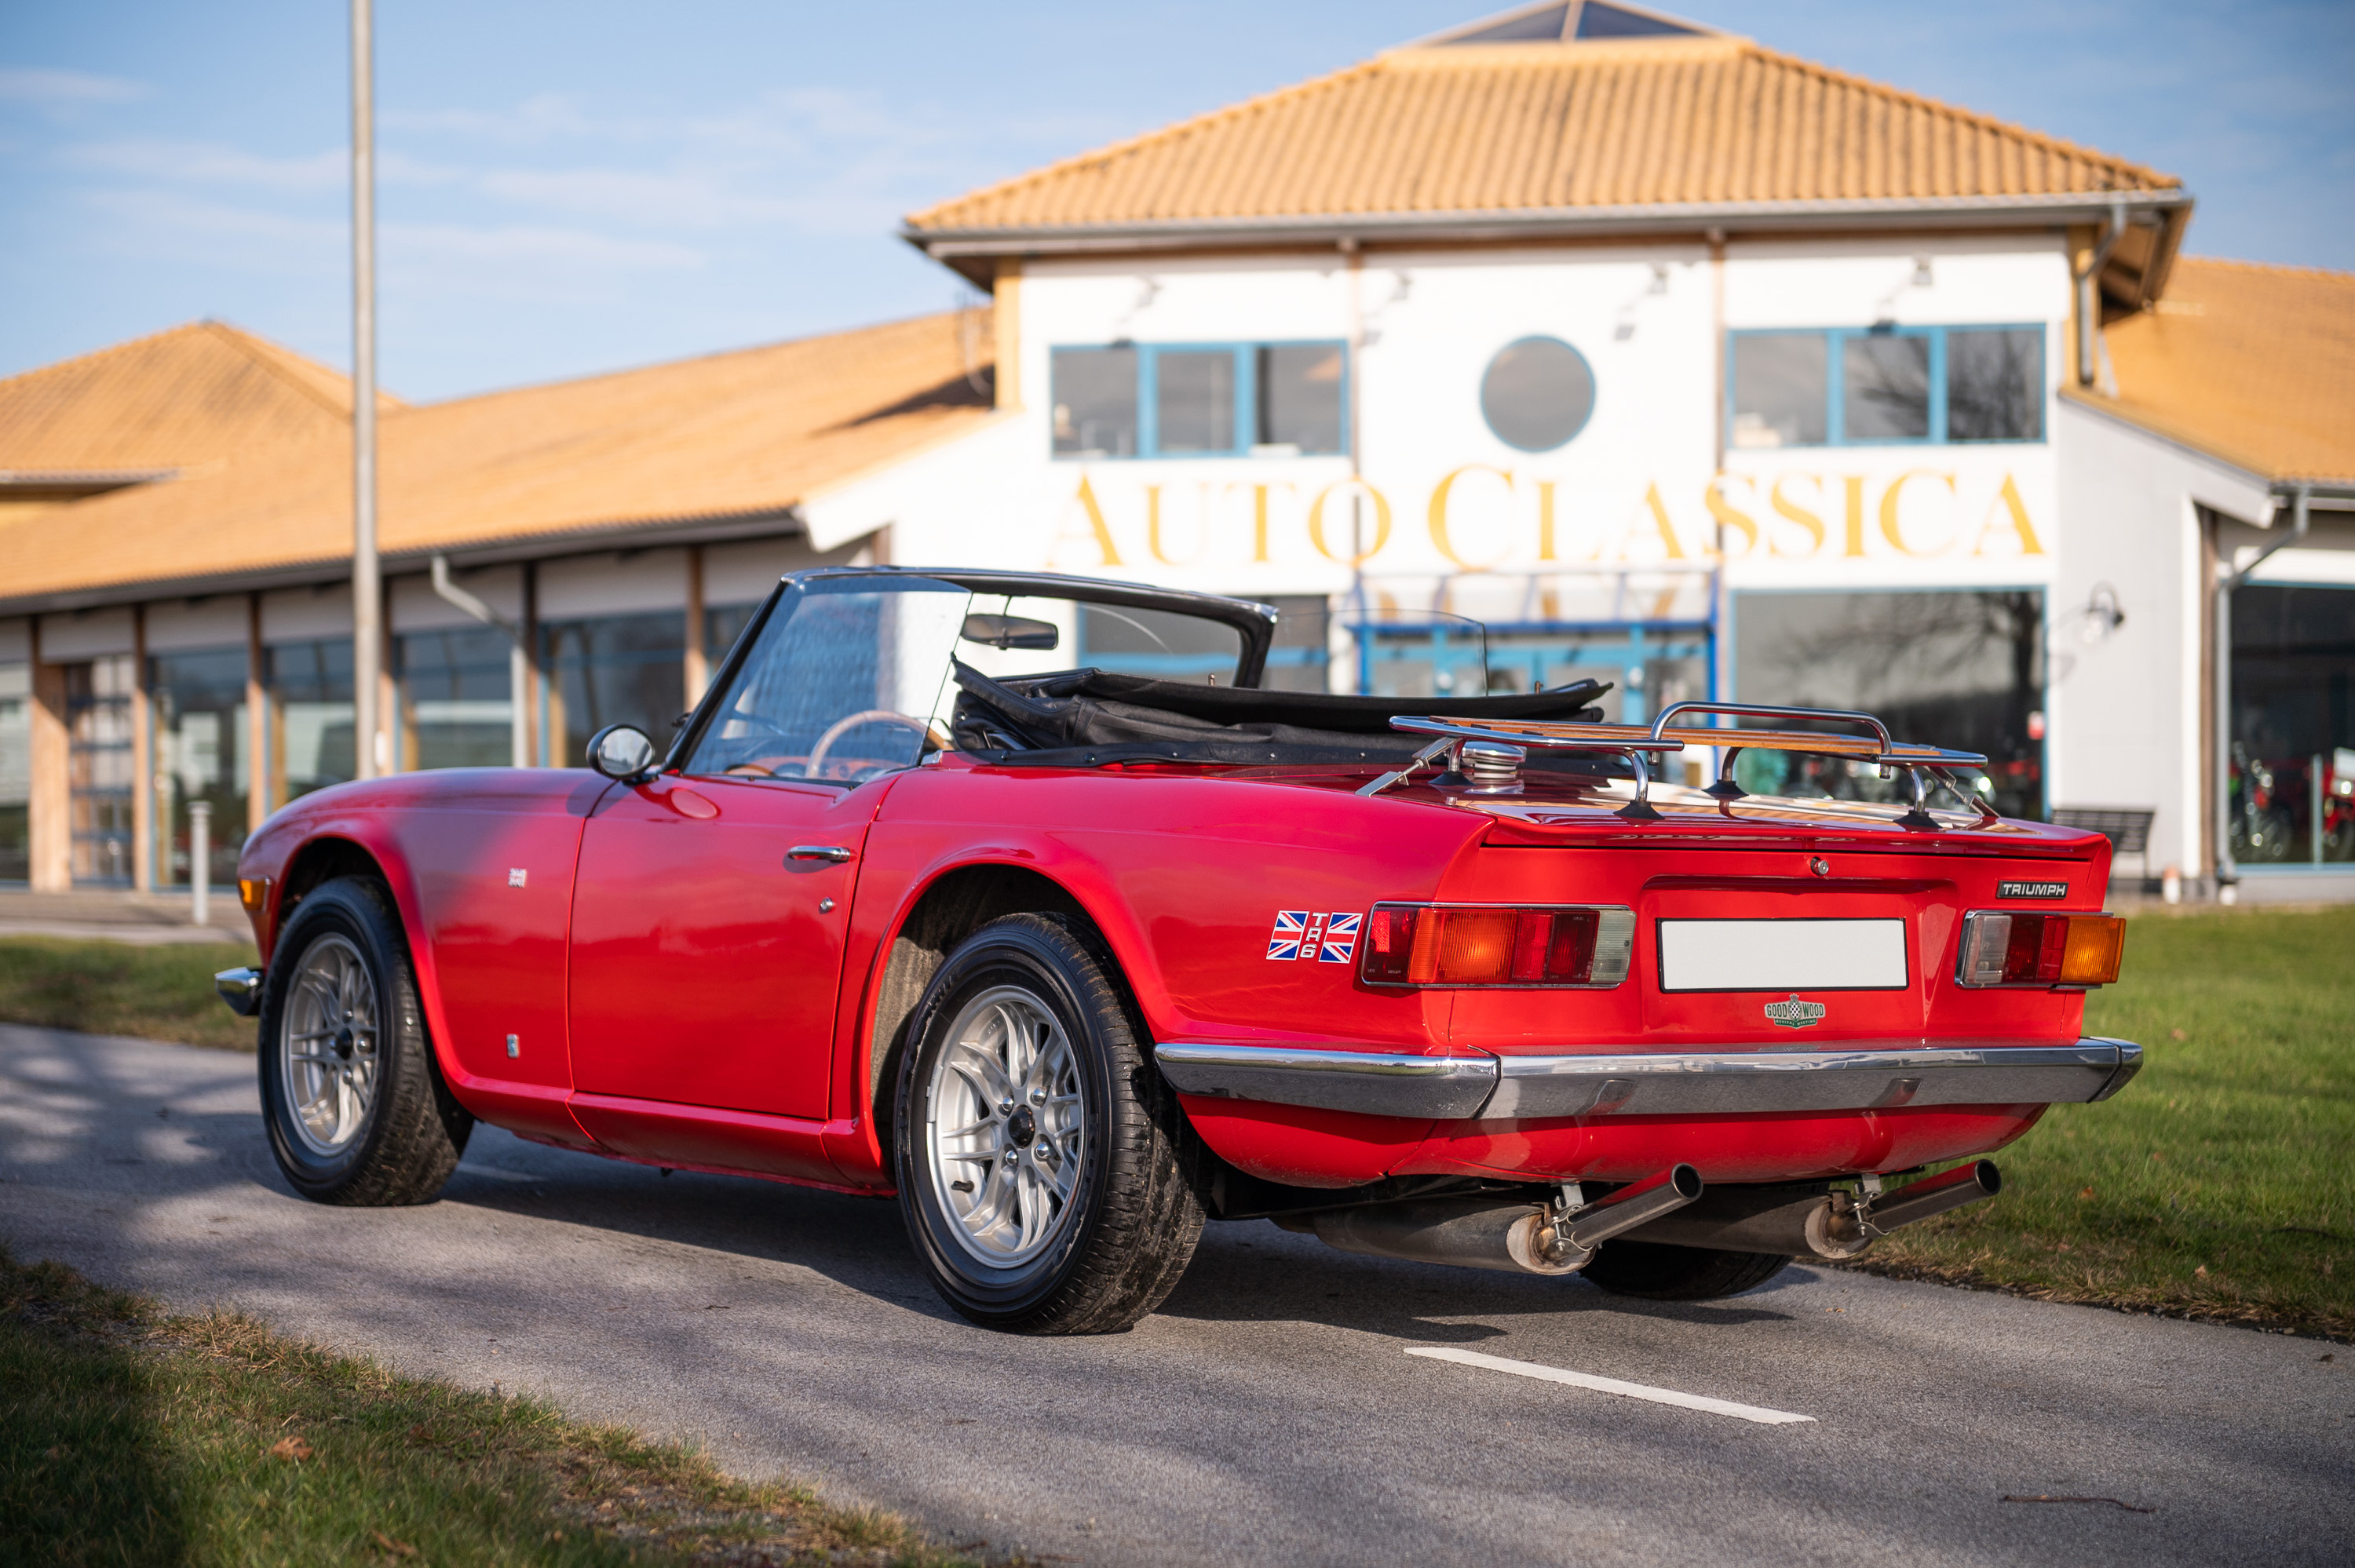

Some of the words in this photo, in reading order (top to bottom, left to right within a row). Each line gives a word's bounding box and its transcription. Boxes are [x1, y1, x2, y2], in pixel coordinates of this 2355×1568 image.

[1045, 469, 1393, 569] AUTO
[1426, 461, 2047, 572] CLASSICA
[2003, 883, 2066, 896] TRIUMPH
[1299, 912, 1330, 959] TR6
[1766, 1003, 1787, 1018] GOOD
[1802, 1002, 1824, 1018] WOOD
